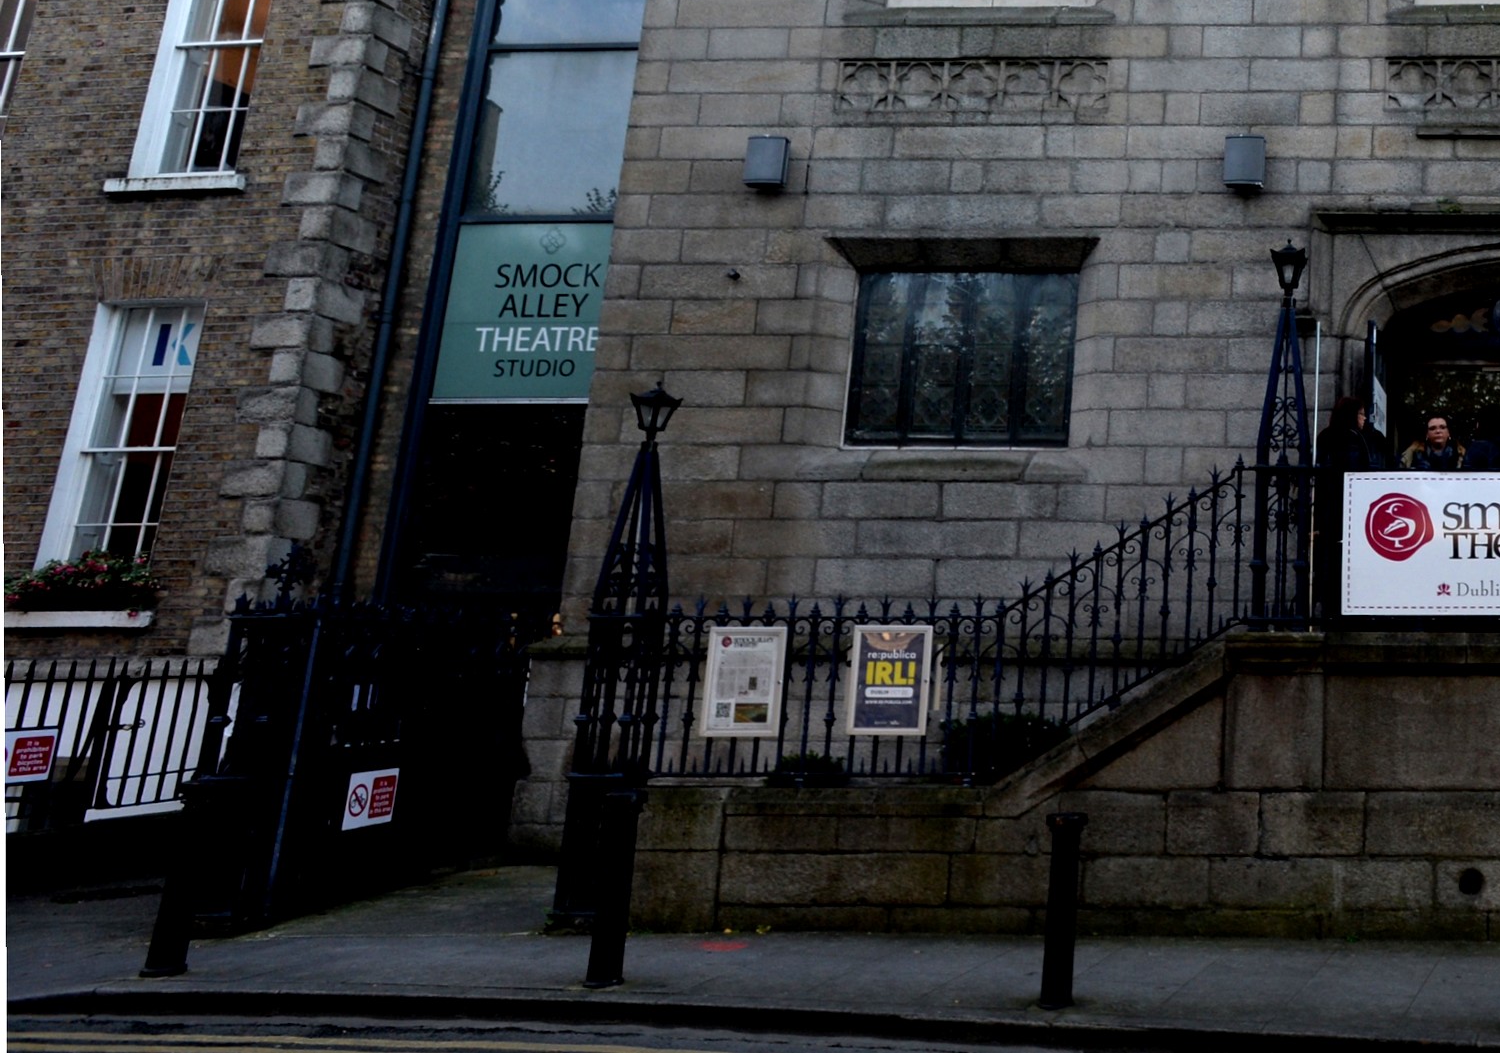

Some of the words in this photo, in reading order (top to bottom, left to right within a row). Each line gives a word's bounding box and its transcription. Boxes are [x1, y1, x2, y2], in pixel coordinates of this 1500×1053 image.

[494, 264, 602, 288] SMOCK
[498, 294, 589, 318] ALLEY
[476, 327, 598, 352] THEATRE
[494, 359, 575, 377] STUDIO
[868, 649, 916, 660] re:publica
[866, 661, 916, 685] IRL!
[16, 746, 49, 754] prohibited
